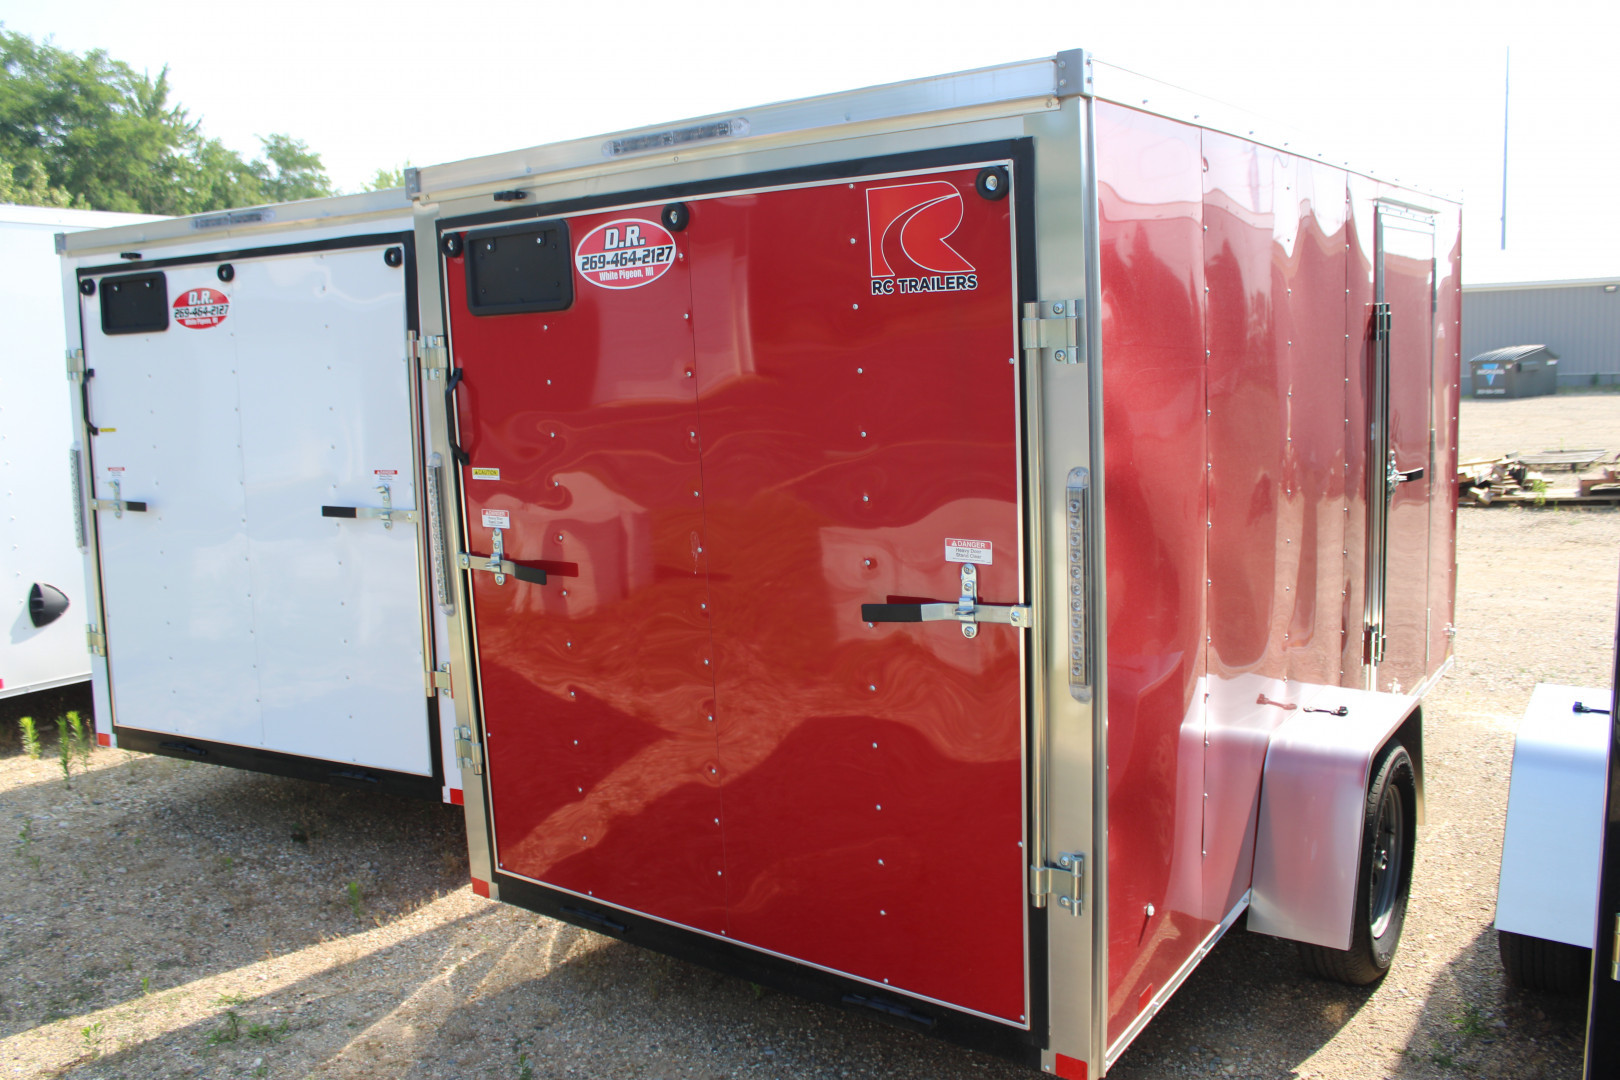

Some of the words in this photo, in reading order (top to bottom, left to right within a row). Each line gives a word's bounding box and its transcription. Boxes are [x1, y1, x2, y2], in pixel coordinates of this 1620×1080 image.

[604, 224, 646, 250] D.R.
[581, 246, 673, 271] 269-464-2127
[599, 271, 618, 281] White
[619, 268, 643, 280] Pigeon,
[645, 266, 654, 276] MI
[871, 279, 894, 295] RC
[897, 274, 978, 293] TRAILERS
[188, 290, 214, 305] D.R.
[174, 305, 229, 318] 269-464-2127
[957, 540, 986, 549] DANGER
